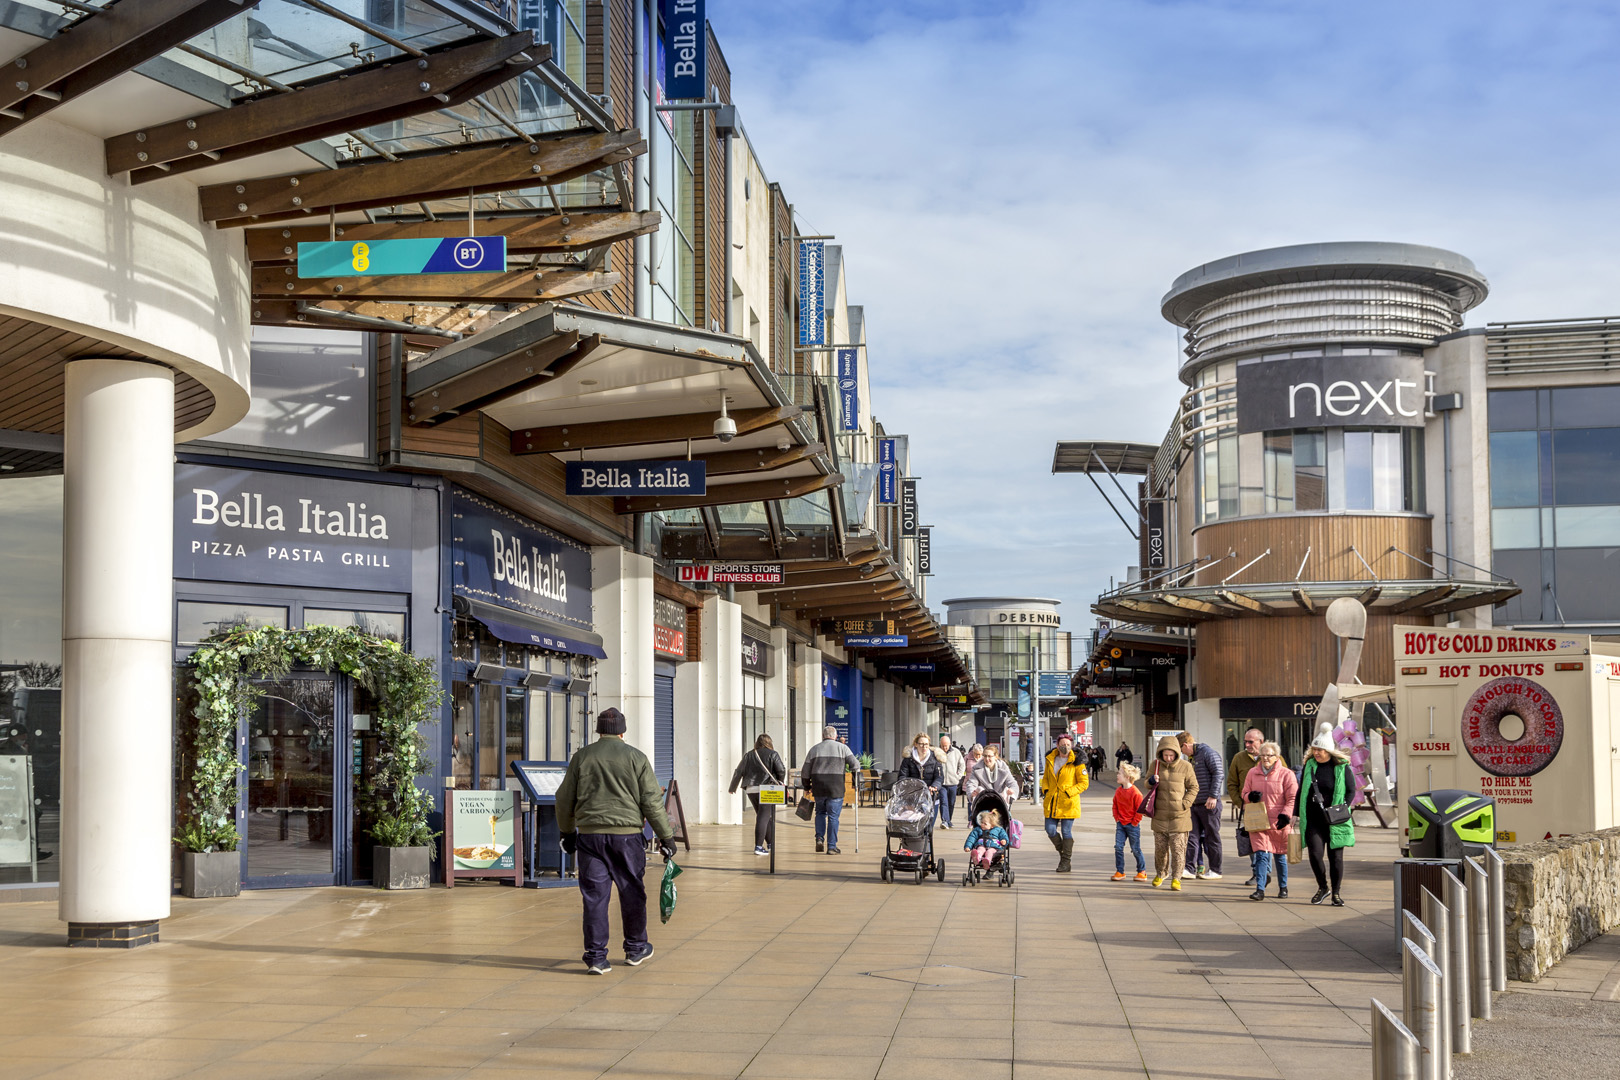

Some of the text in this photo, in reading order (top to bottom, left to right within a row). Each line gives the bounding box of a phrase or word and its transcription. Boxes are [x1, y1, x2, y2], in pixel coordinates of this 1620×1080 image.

[674, 20, 696, 78] Bella
[460, 247, 478, 260] BT
[1289, 379, 1418, 418] next
[581, 468, 690, 488] Bella Italia
[192, 488, 389, 540] Bella Italia
[904, 486, 914, 530] OUTFIT
[192, 541, 390, 568] PIZZA PASTA GRILL
[920, 533, 928, 569] OUTFIT
[1150, 528, 1162, 564] next
[491, 528, 568, 603] Bella Italia
[682, 565, 710, 580] DW
[714, 564, 781, 573] SPORTS STORE
[714, 573, 780, 582] FITNESS CLUB
[667, 604, 684, 628] STORE
[844, 620, 864, 630] COFFEE
[670, 631, 683, 654] CLUB
[1497, 637, 1556, 653] DRINKS
[1439, 664, 1544, 678] HOT DONUTS
[1294, 702, 1321, 715] nex
[1469, 684, 1556, 740] BIG ENOUGH TO COPE
[1412, 742, 1450, 751] SLUSH
[1472, 744, 1551, 754] SMALL ENOUGH
[1490, 756, 1534, 765] TO CARE
[1481, 777, 1532, 787] TO HIRE ME
